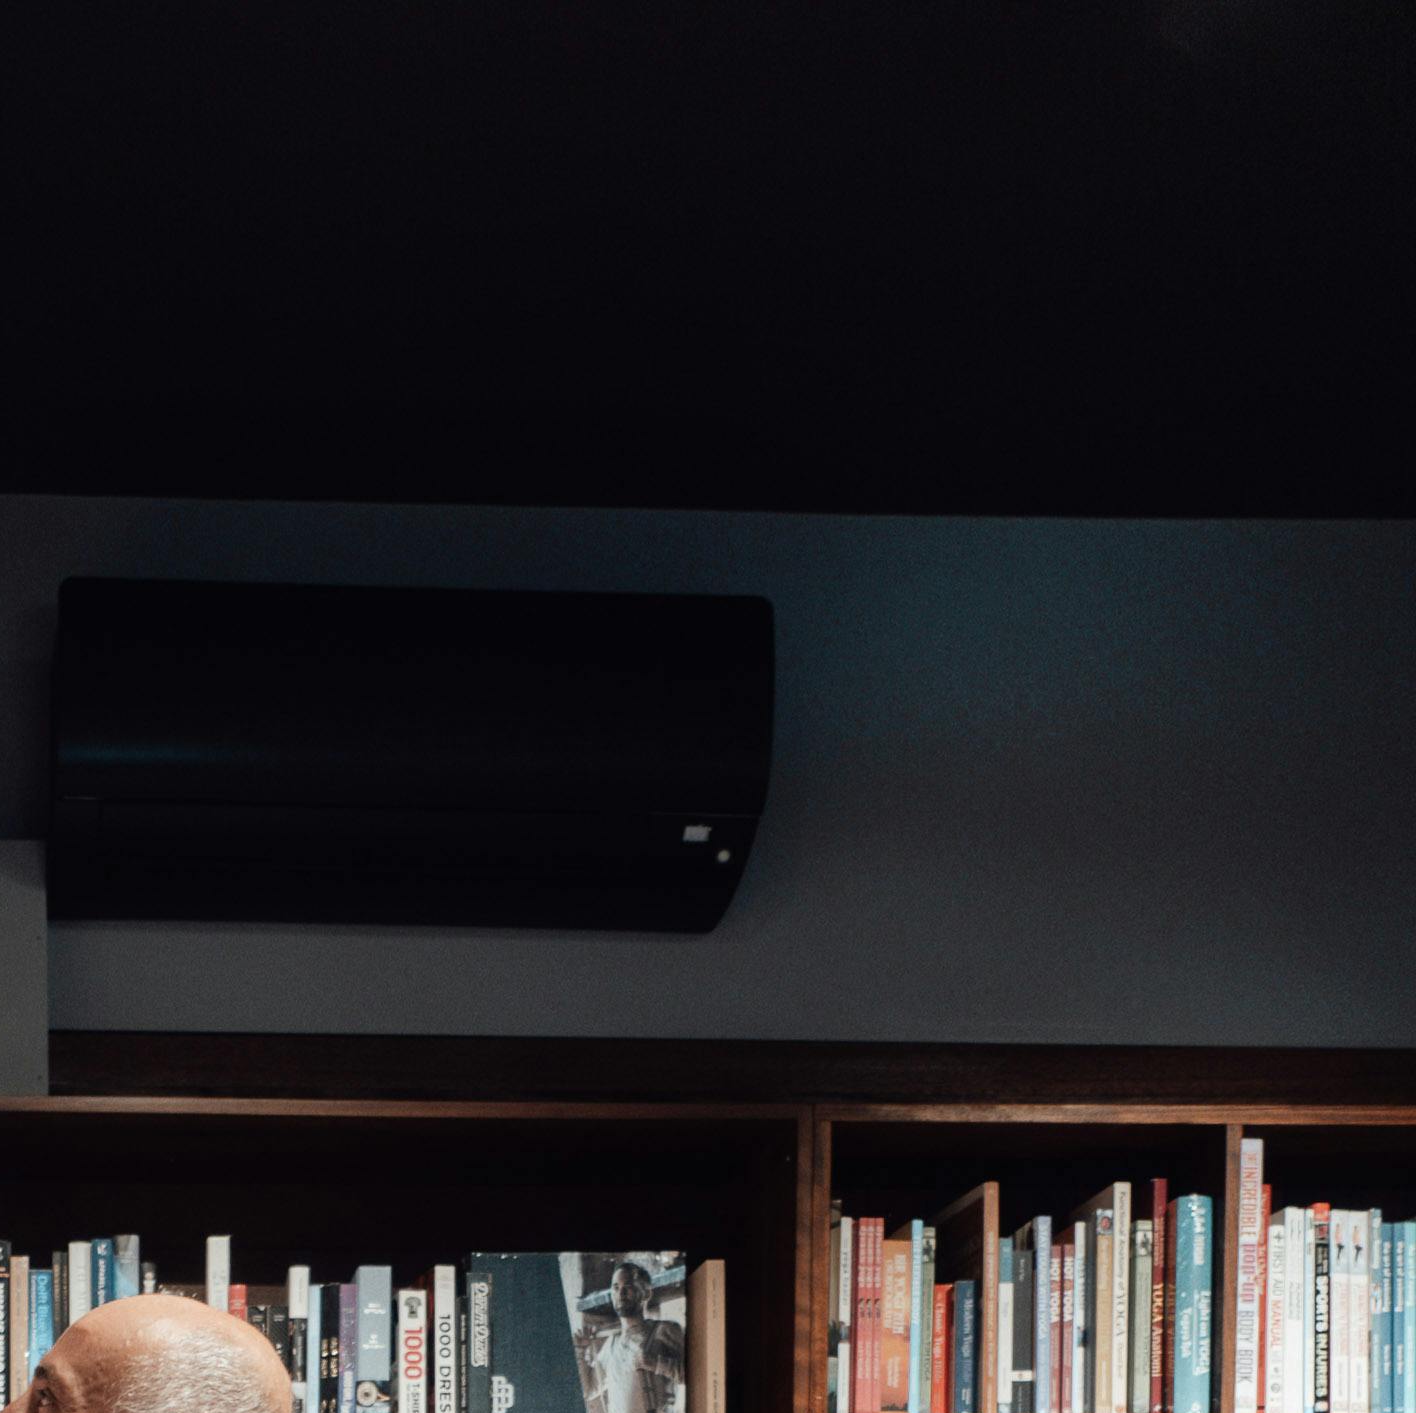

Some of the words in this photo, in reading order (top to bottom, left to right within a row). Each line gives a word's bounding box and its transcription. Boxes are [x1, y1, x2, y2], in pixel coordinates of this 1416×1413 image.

[1239, 1166, 1258, 1238] INCREDIBLE
[1239, 1243, 1258, 1304] pop-up
[962, 1299, 974, 1335] Modern
[1115, 1294, 1127, 1338] YOGA
[1152, 1282, 1164, 1324] YOGA
[1270, 1299, 1284, 1349] MANUAL
[1316, 1275, 1329, 1333] SPORTS
[439, 1314, 452, 1358] 1000
[959, 1336, 973, 1358] Yoga
[1038, 1313, 1049, 1340] YOGA
[1238, 1310, 1255, 1341] BODY
[404, 1327, 424, 1380] 1000
[933, 1337, 944, 1359] Yoga
[1196, 1338, 1210, 1375] YOGA
[1236, 1348, 1253, 1382] BOOK
[1315, 1333, 1329, 1397] INJURIES
